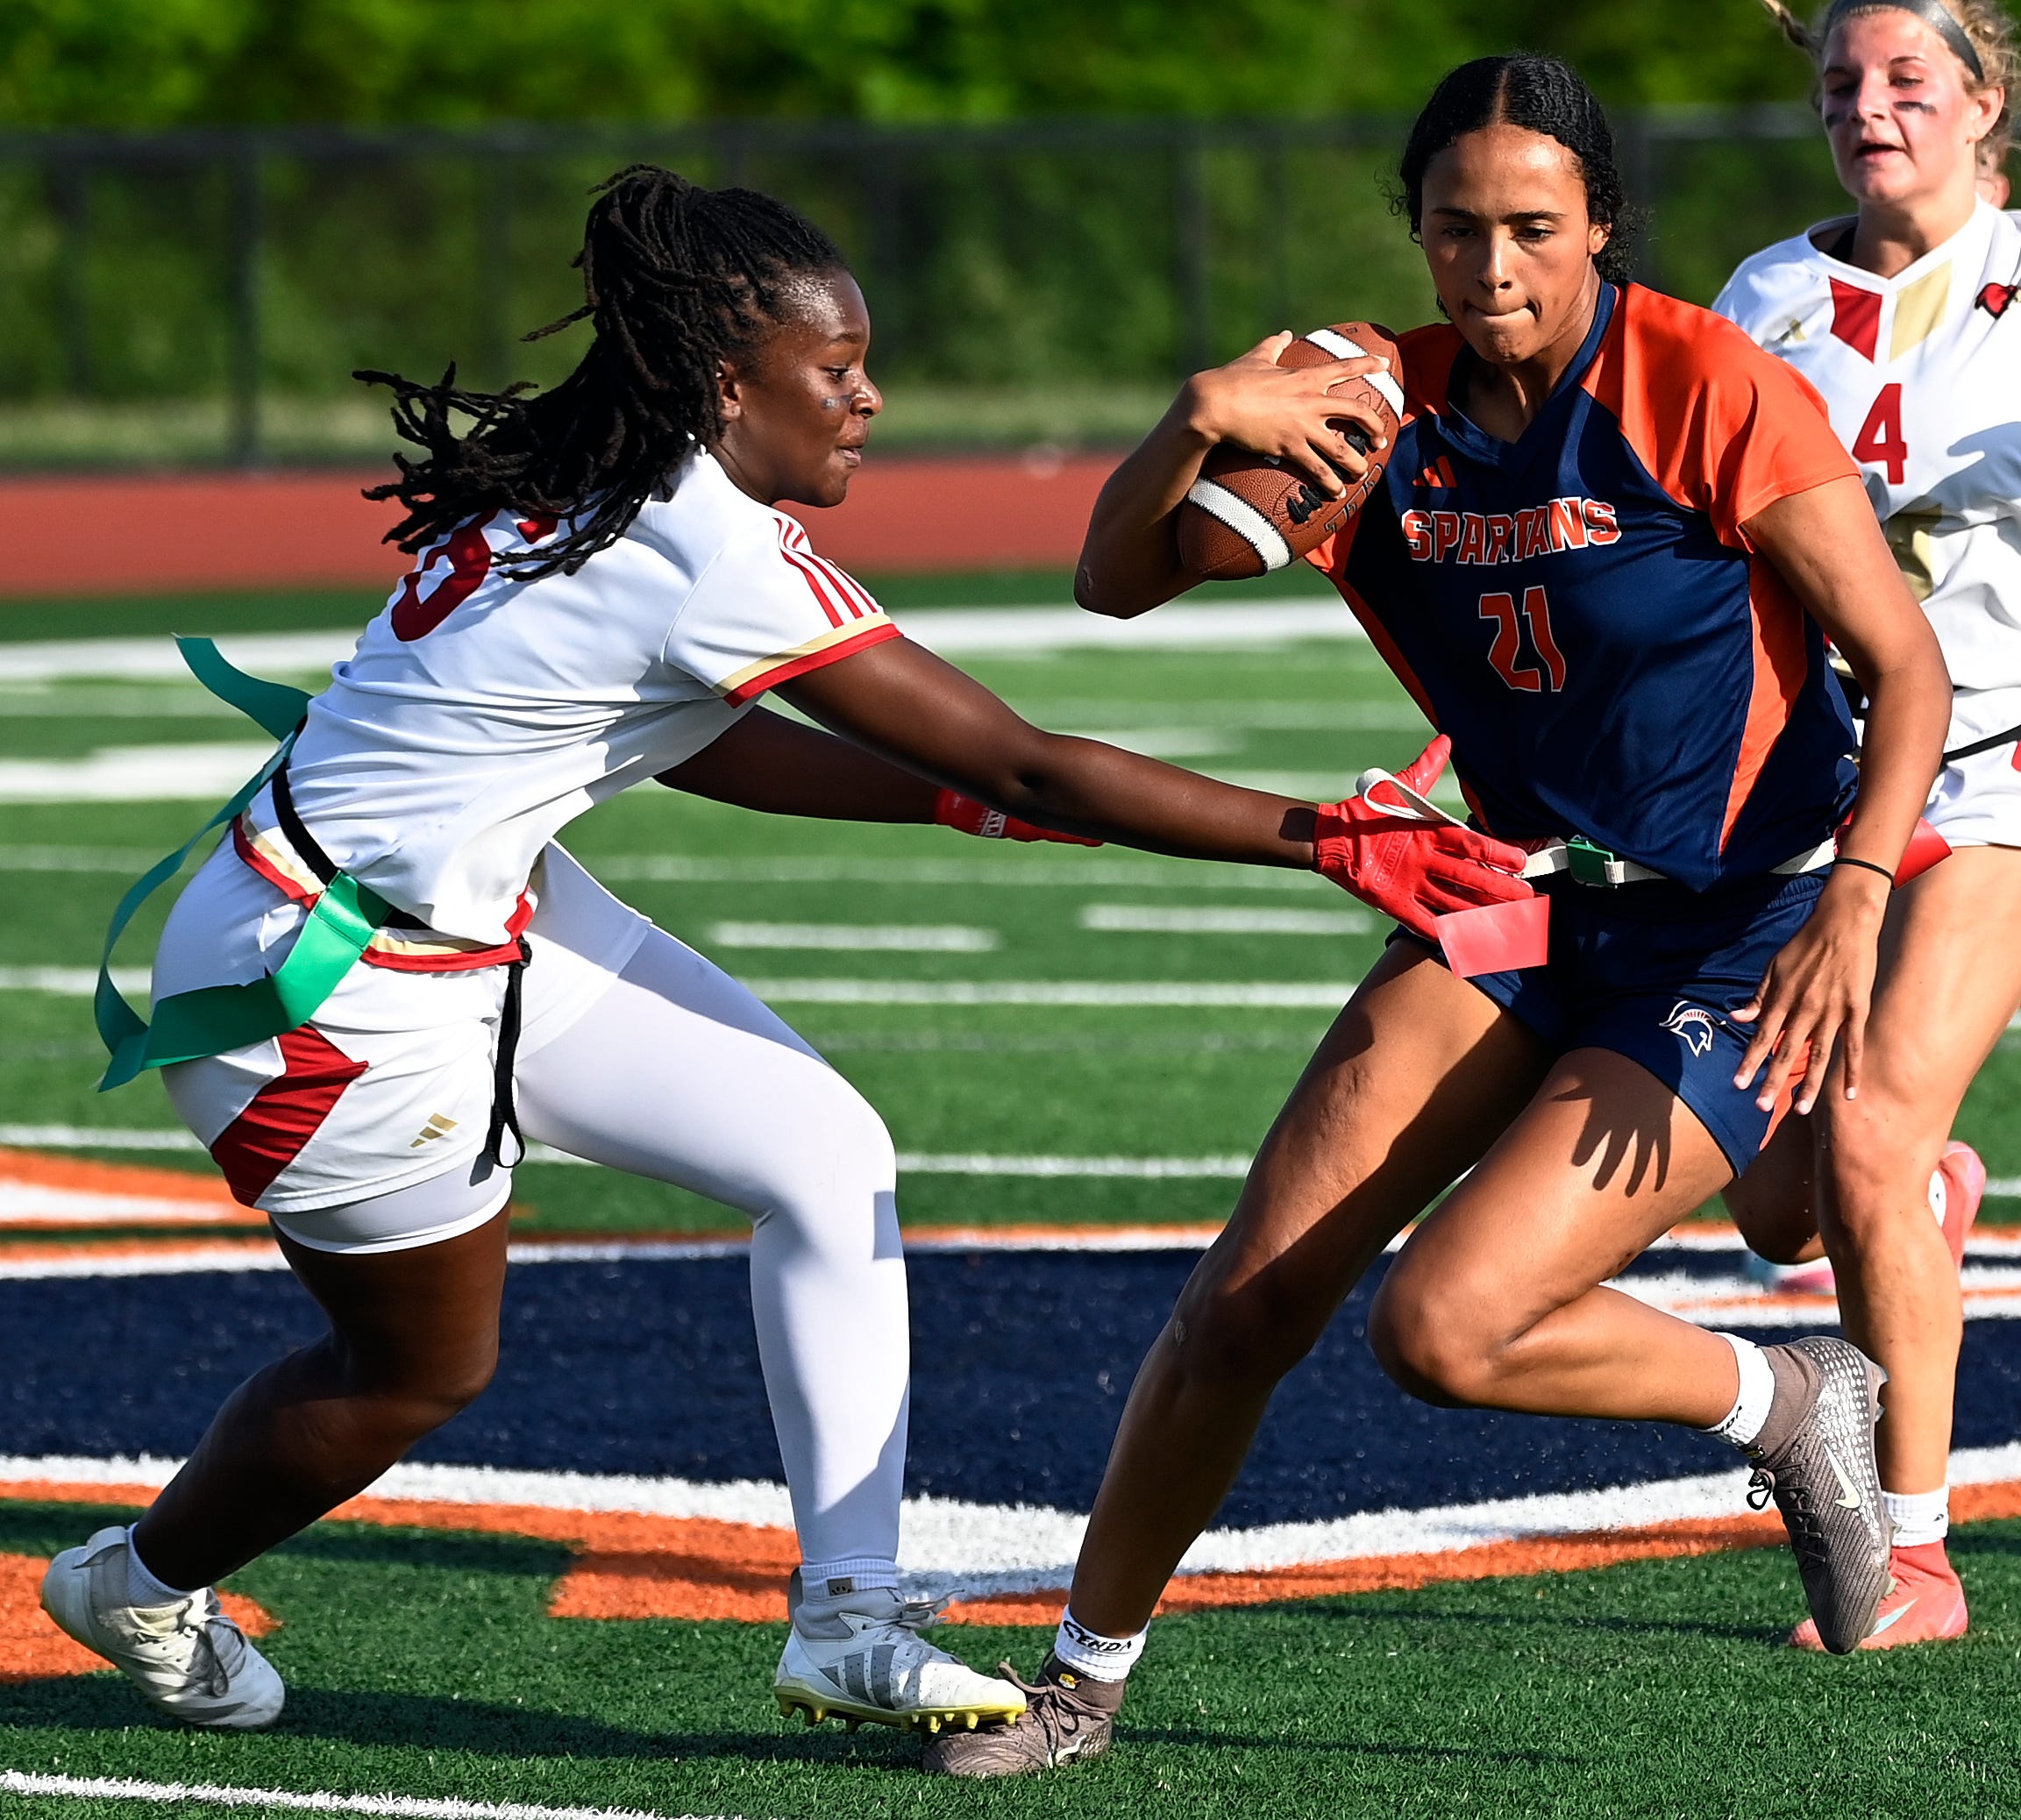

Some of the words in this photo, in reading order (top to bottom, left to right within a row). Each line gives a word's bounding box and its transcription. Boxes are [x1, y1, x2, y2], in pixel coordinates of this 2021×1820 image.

[1852, 383, 1908, 485] 4
[1402, 496, 1622, 565] SPARTANS
[1479, 585, 1566, 693] 21
